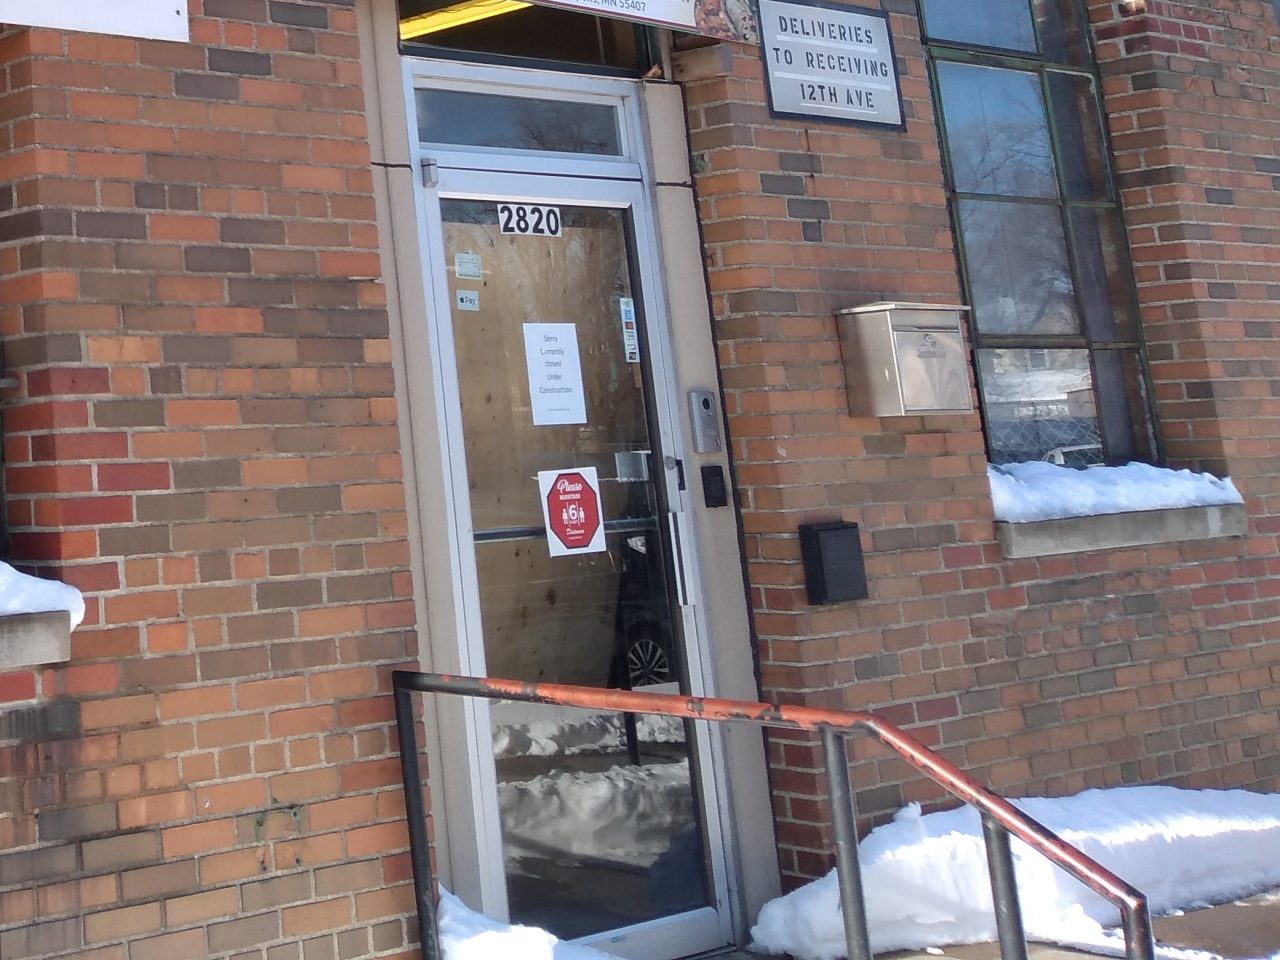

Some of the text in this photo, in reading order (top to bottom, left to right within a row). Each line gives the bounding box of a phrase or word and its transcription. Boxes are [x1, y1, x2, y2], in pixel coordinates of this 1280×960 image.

[620, 0, 646, 11] 55407
[779, 16, 873, 44] DELIVERIES
[773, 47, 888, 77] TO RECEIVING
[800, 83, 874, 108] 12TH AVE
[500, 206, 559, 235] 2820
[465, 297, 475, 306] Pay
[557, 479, 582, 493] Please
[569, 505, 577, 520] 6
